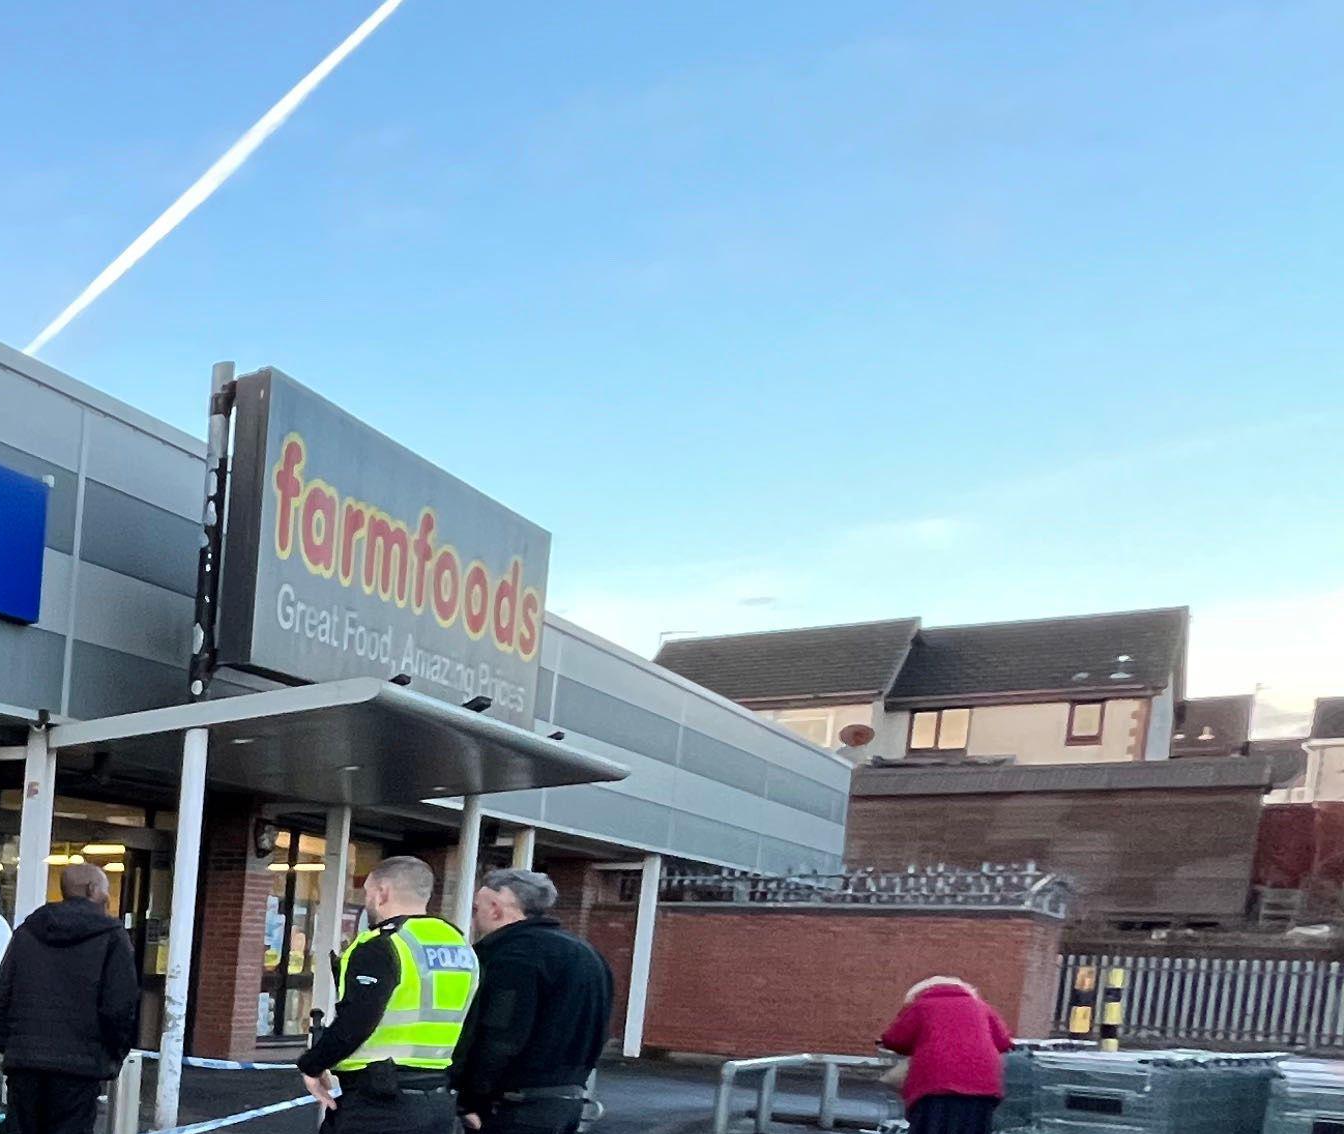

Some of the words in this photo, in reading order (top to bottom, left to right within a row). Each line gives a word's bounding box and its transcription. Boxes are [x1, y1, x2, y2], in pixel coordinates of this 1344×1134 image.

[274, 434, 539, 661] farmfoods
[276, 583, 339, 648] Great
[343, 609, 395, 676] Food,
[400, 633, 475, 700] Amazng
